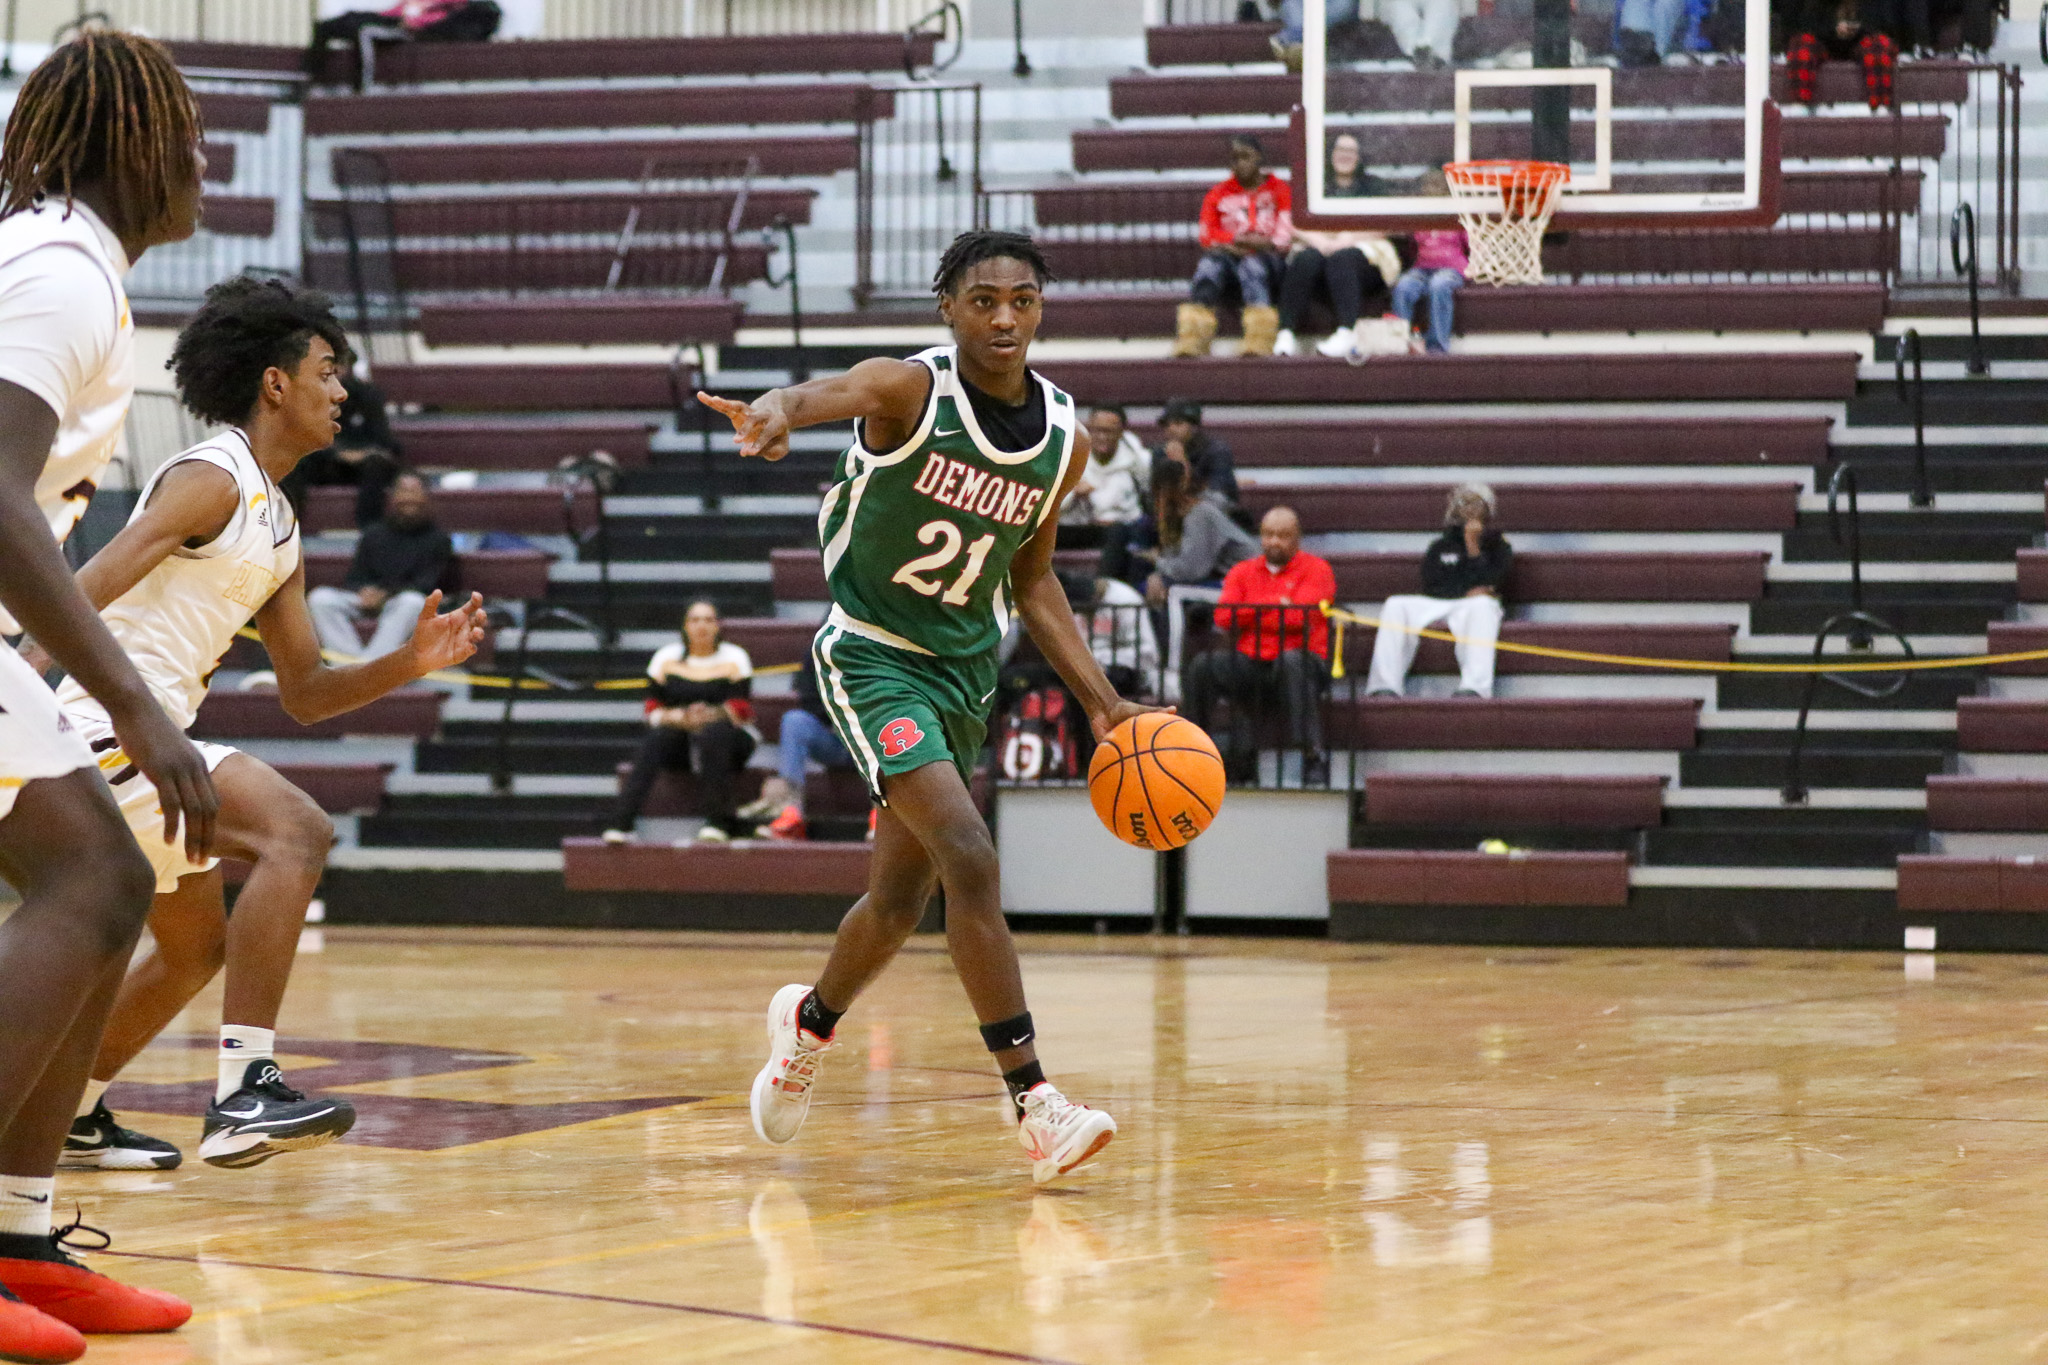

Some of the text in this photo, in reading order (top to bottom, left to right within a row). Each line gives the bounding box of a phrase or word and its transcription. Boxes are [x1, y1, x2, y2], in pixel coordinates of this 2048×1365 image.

[913, 450, 1045, 526] DEMONS
[891, 519, 996, 607] 21
[878, 717, 925, 758] R
